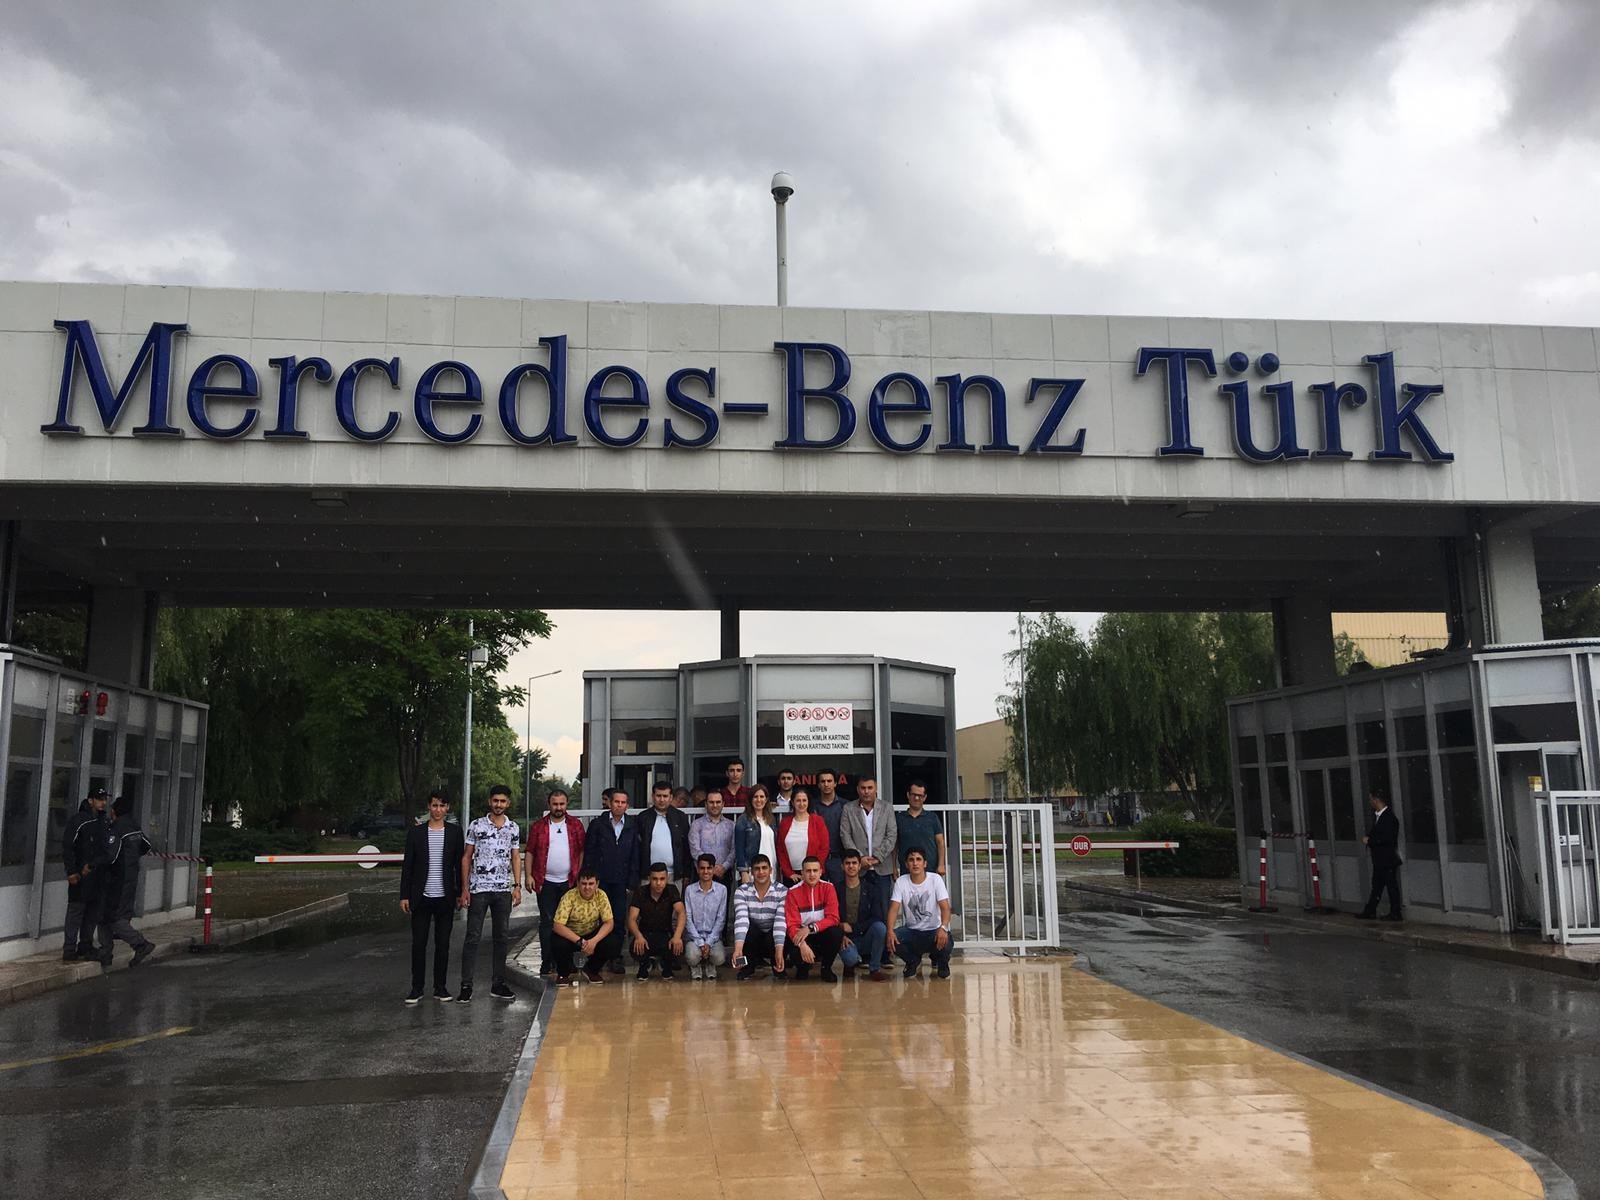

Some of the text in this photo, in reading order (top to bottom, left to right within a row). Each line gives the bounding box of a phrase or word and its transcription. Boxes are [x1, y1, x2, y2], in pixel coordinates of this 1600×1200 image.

[41, 319, 1455, 465] Mercedes-Benz Türk
[1073, 841, 1089, 850] DUR
